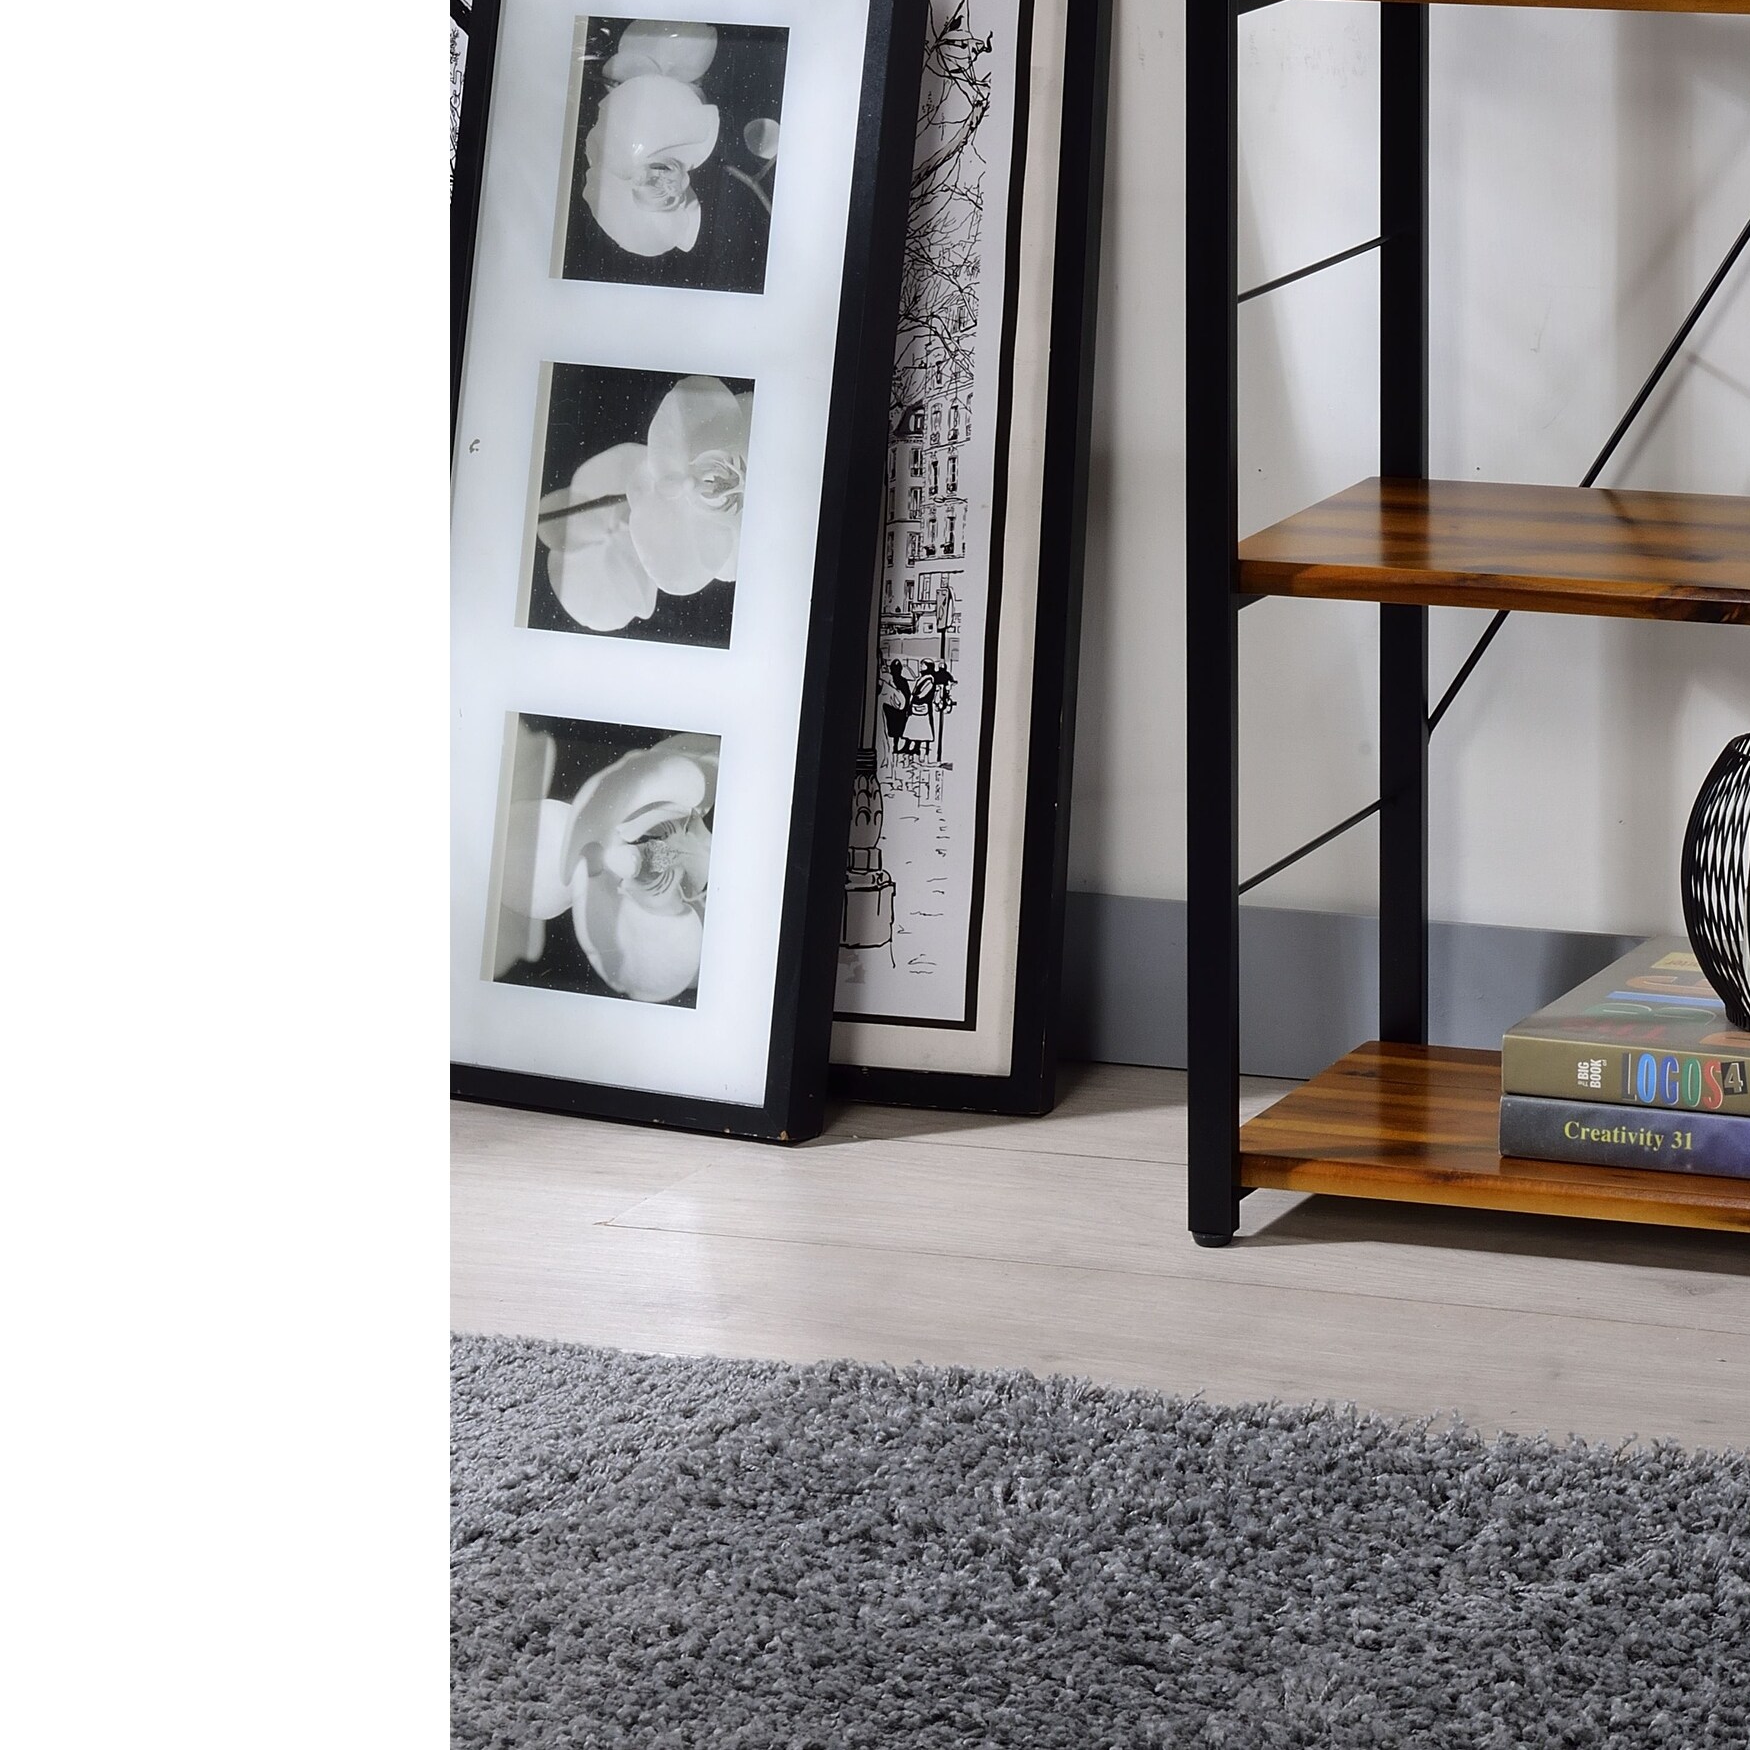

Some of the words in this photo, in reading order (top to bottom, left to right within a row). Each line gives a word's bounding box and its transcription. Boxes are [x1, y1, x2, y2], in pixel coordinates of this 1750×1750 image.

[1577, 1061, 1590, 1080] BIG
[1590, 1058, 1602, 1088] BOOK
[1622, 1052, 1724, 1110] LOGOS
[1564, 1121, 1664, 1151] Creativity
[1671, 1131, 1693, 1150] 31
